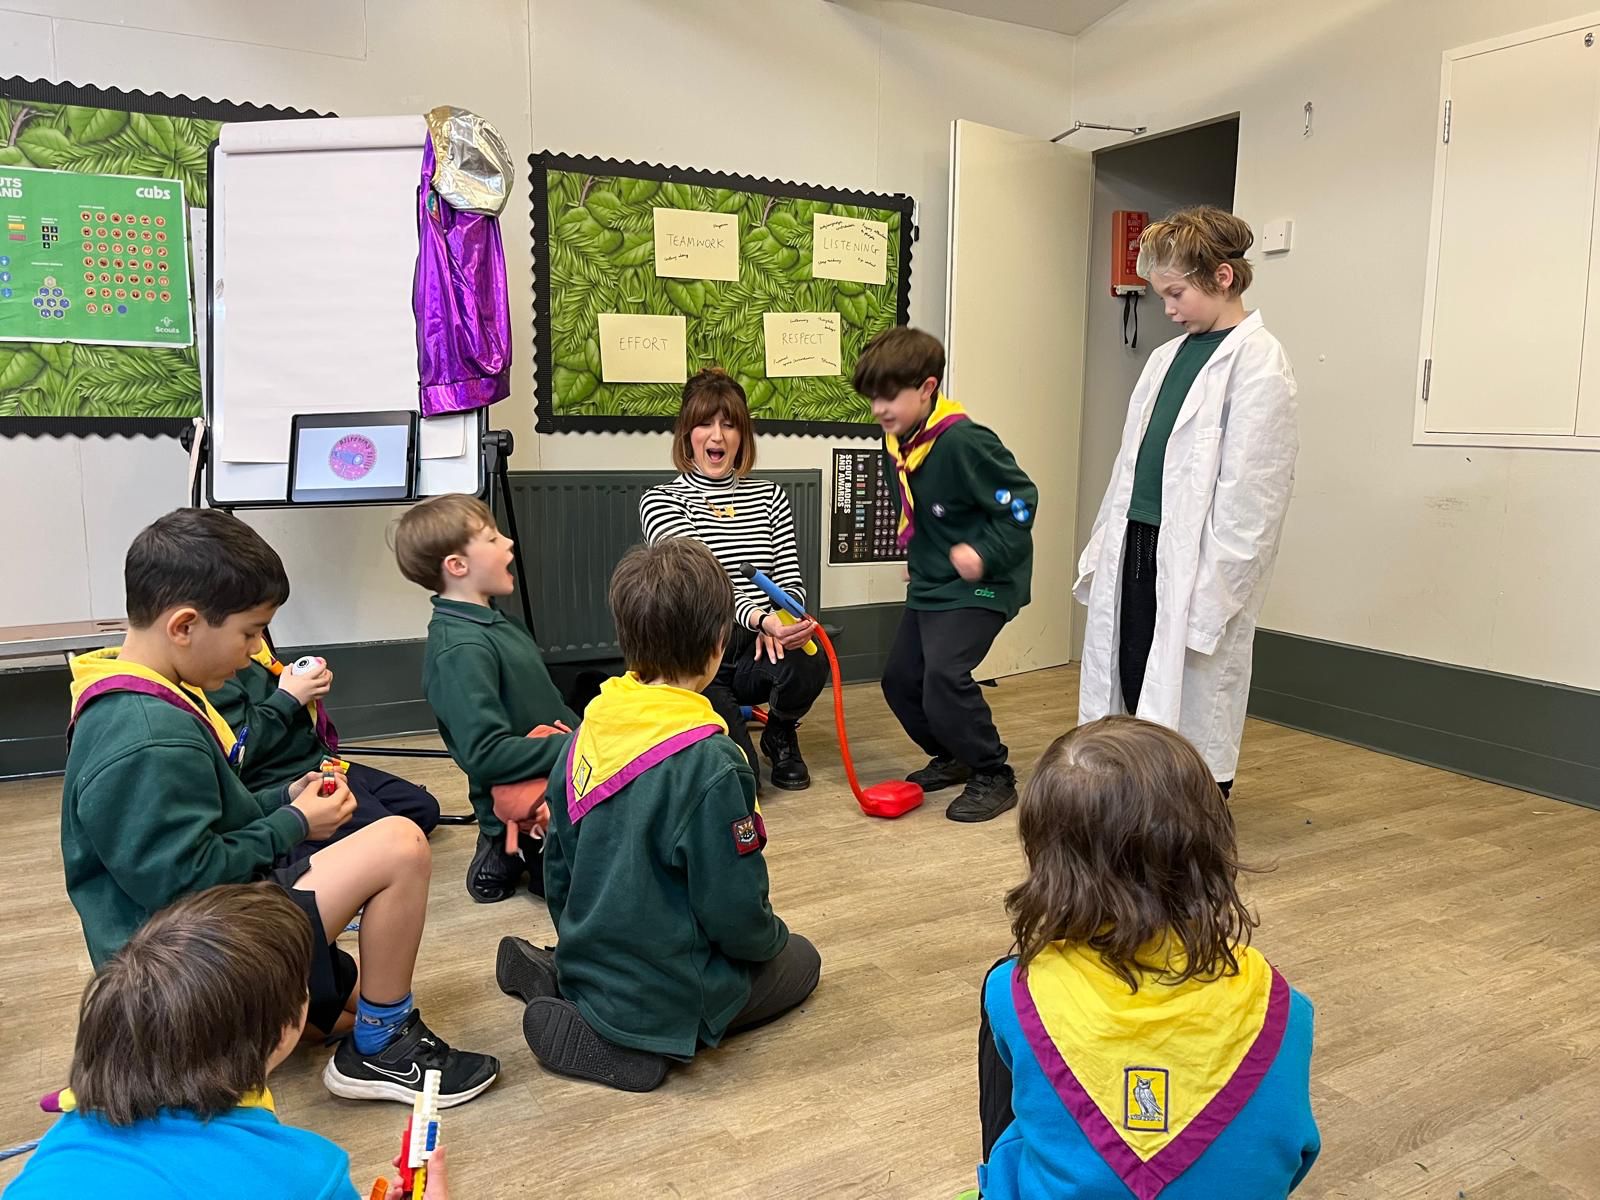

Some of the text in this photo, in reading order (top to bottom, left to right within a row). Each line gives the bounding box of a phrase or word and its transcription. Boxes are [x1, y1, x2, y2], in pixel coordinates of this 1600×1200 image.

[136, 186, 171, 200] cubs
[666, 233, 725, 249] TEAMWORK
[823, 237, 880, 255] LISTENING
[155, 326, 180, 334] Scouts
[619, 336, 669, 351] EFFORT
[782, 332, 824, 345] RESPECT
[837, 472, 846, 508] AWARDS
[843, 454, 853, 514] SCOUT BADGES
